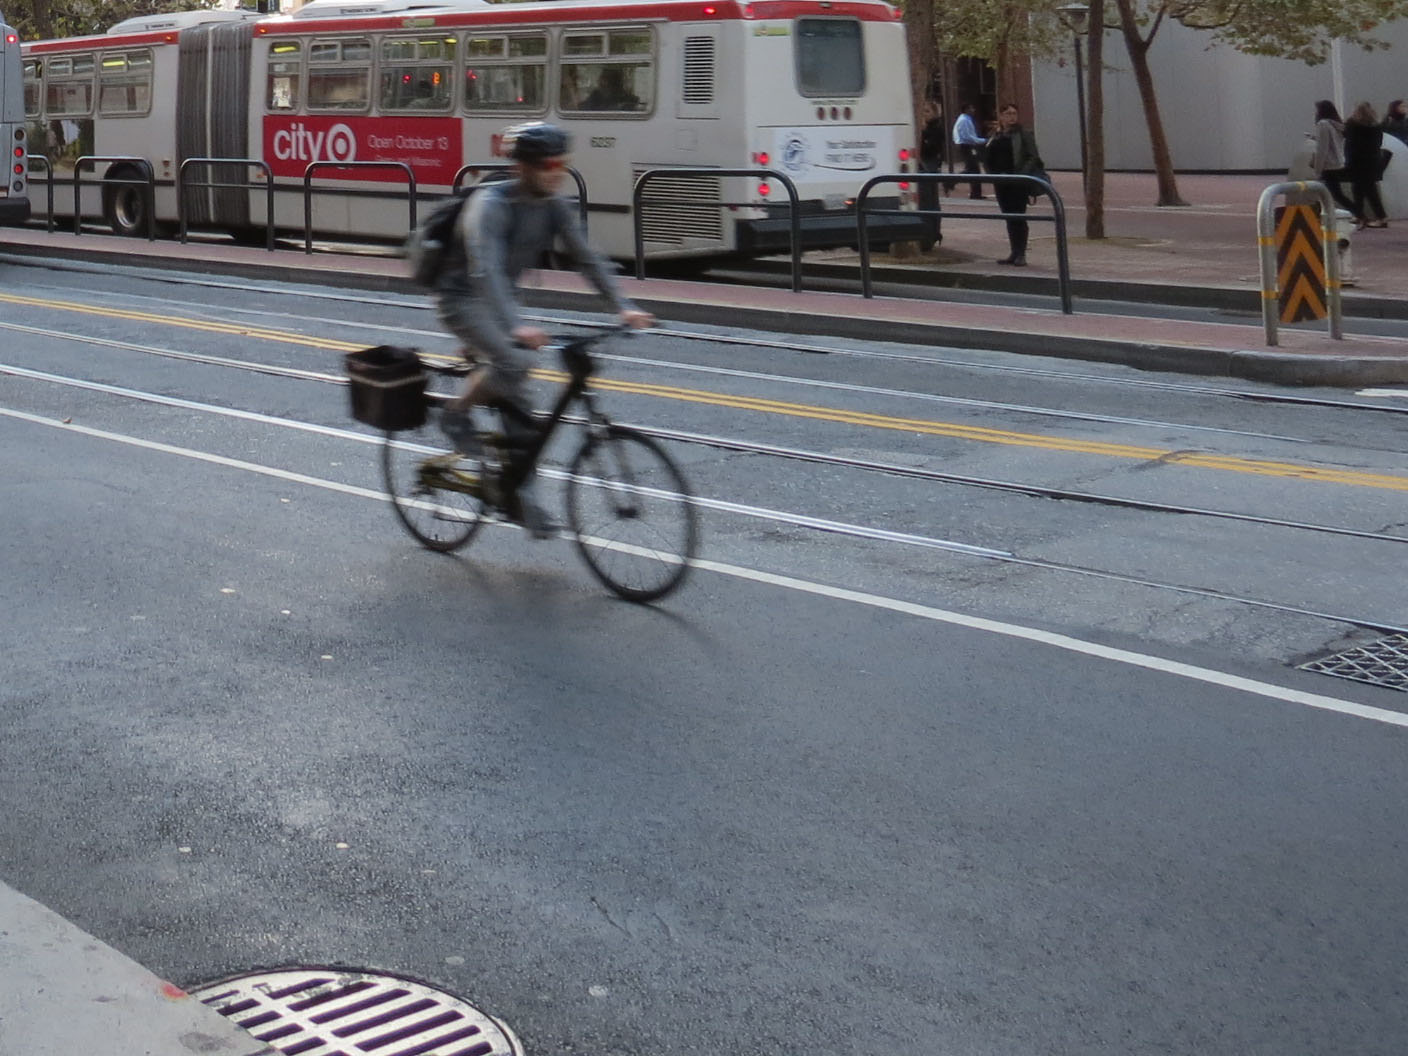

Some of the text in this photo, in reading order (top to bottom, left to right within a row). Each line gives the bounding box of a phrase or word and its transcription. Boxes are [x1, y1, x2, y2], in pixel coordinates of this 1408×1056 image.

[273, 122, 324, 163] city
[368, 134, 393, 152] Open
[395, 135, 435, 151] October
